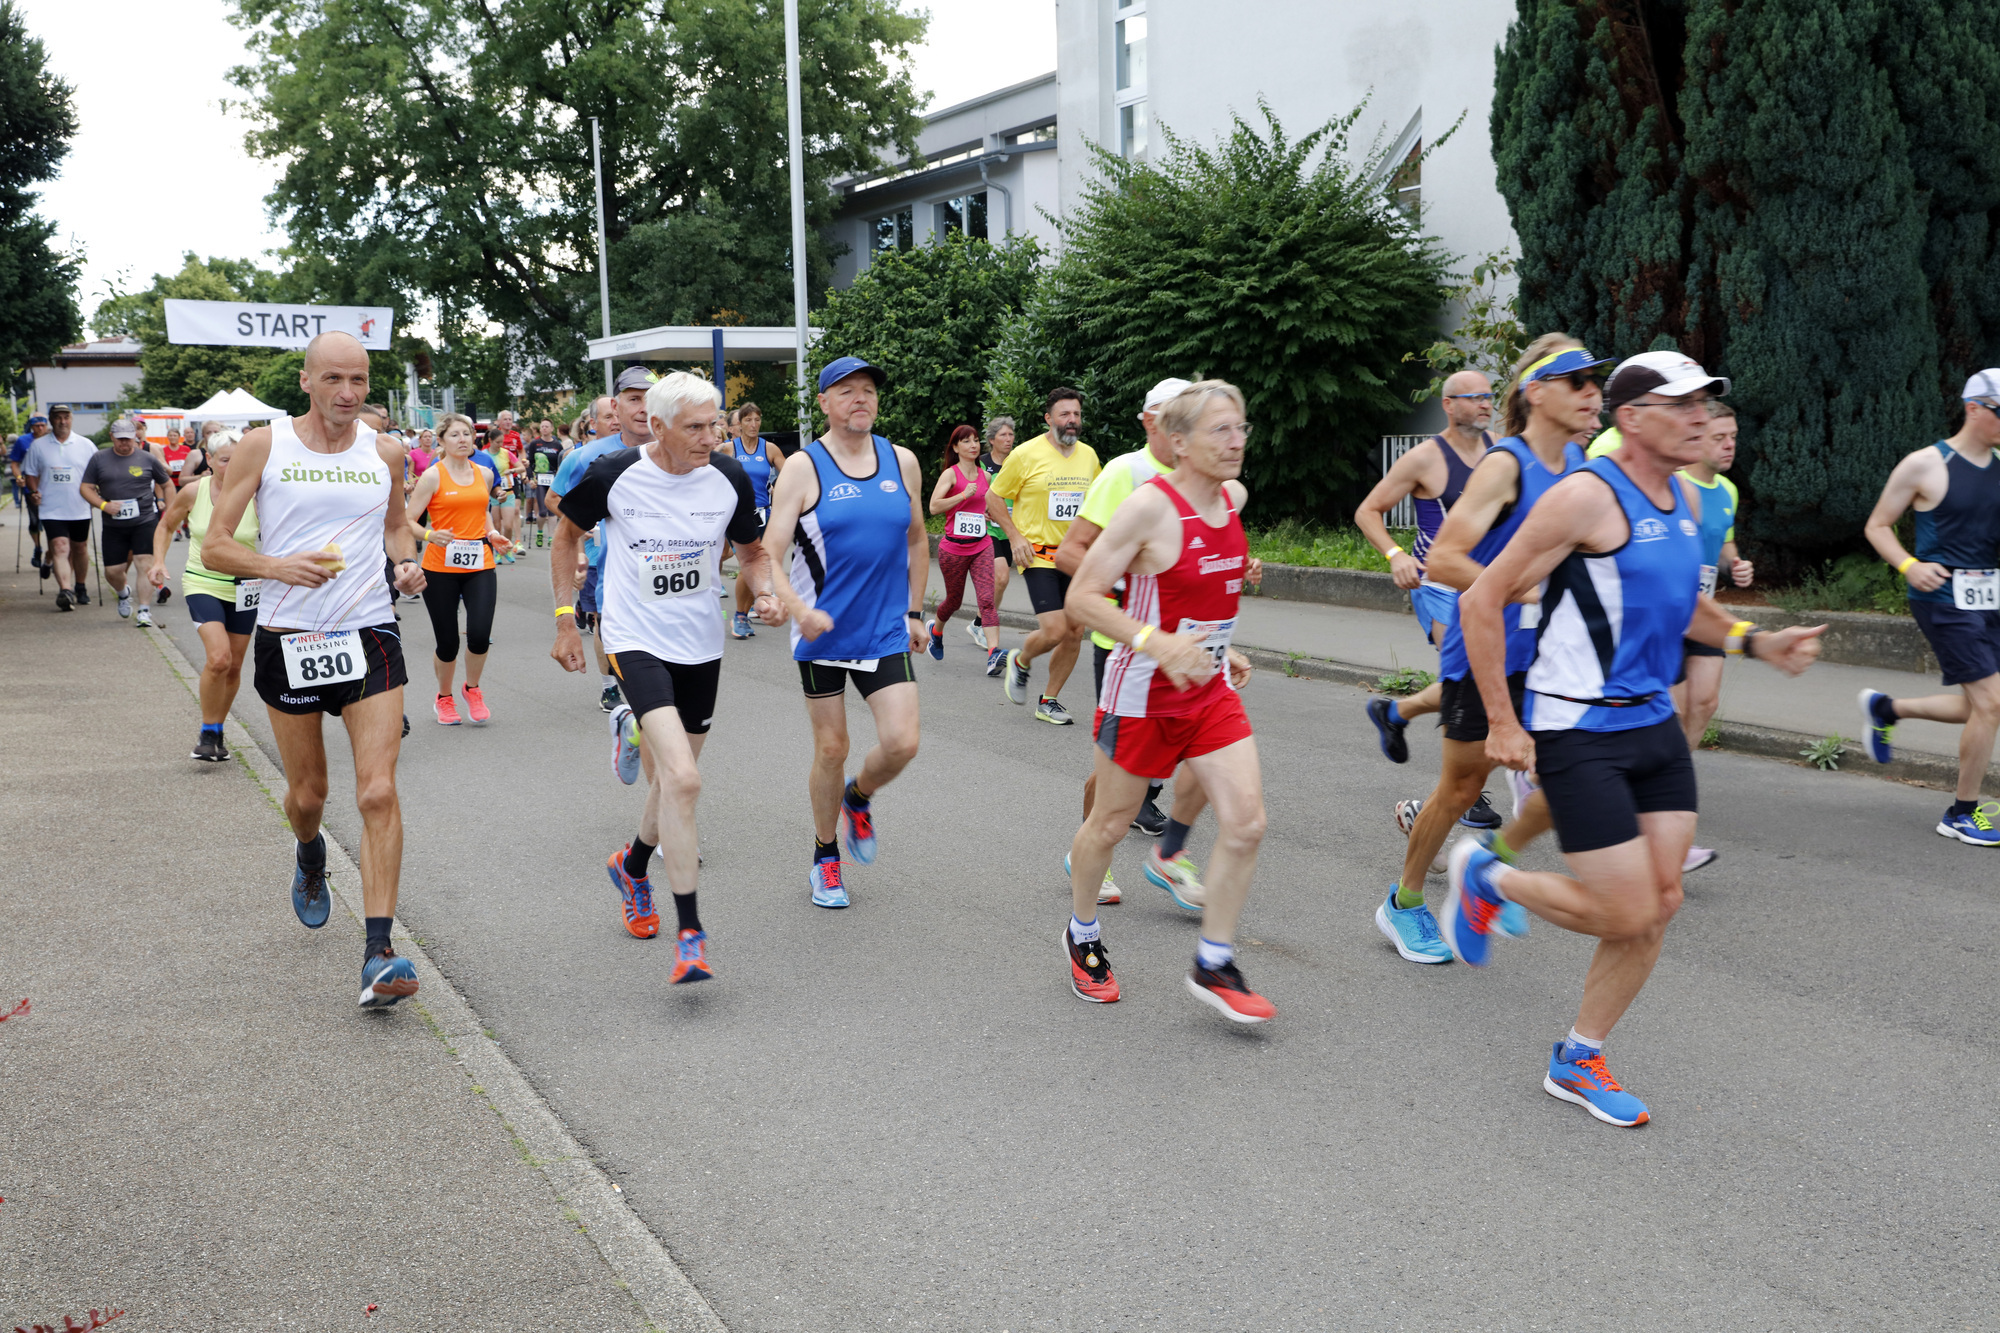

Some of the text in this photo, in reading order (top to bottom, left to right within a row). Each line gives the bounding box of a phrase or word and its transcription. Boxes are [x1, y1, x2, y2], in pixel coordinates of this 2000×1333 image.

[237, 312, 326, 338] START
[53, 474, 71, 482] 929
[623, 508, 635, 516] 100
[1055, 504, 1079, 517] 847
[960, 522, 981, 535] 839
[648, 538, 666, 553] 36.
[452, 552, 478, 566] 837
[654, 549, 705, 562] INTERSPORT
[651, 559, 700, 570] BLESSING
[653, 569, 700, 595] 960
[244, 592, 260, 608] 82
[1965, 588, 1994, 605] 814
[298, 630, 351, 644] INTERSPORT
[296, 639, 348, 653] BLESSING
[300, 652, 353, 681] 830
